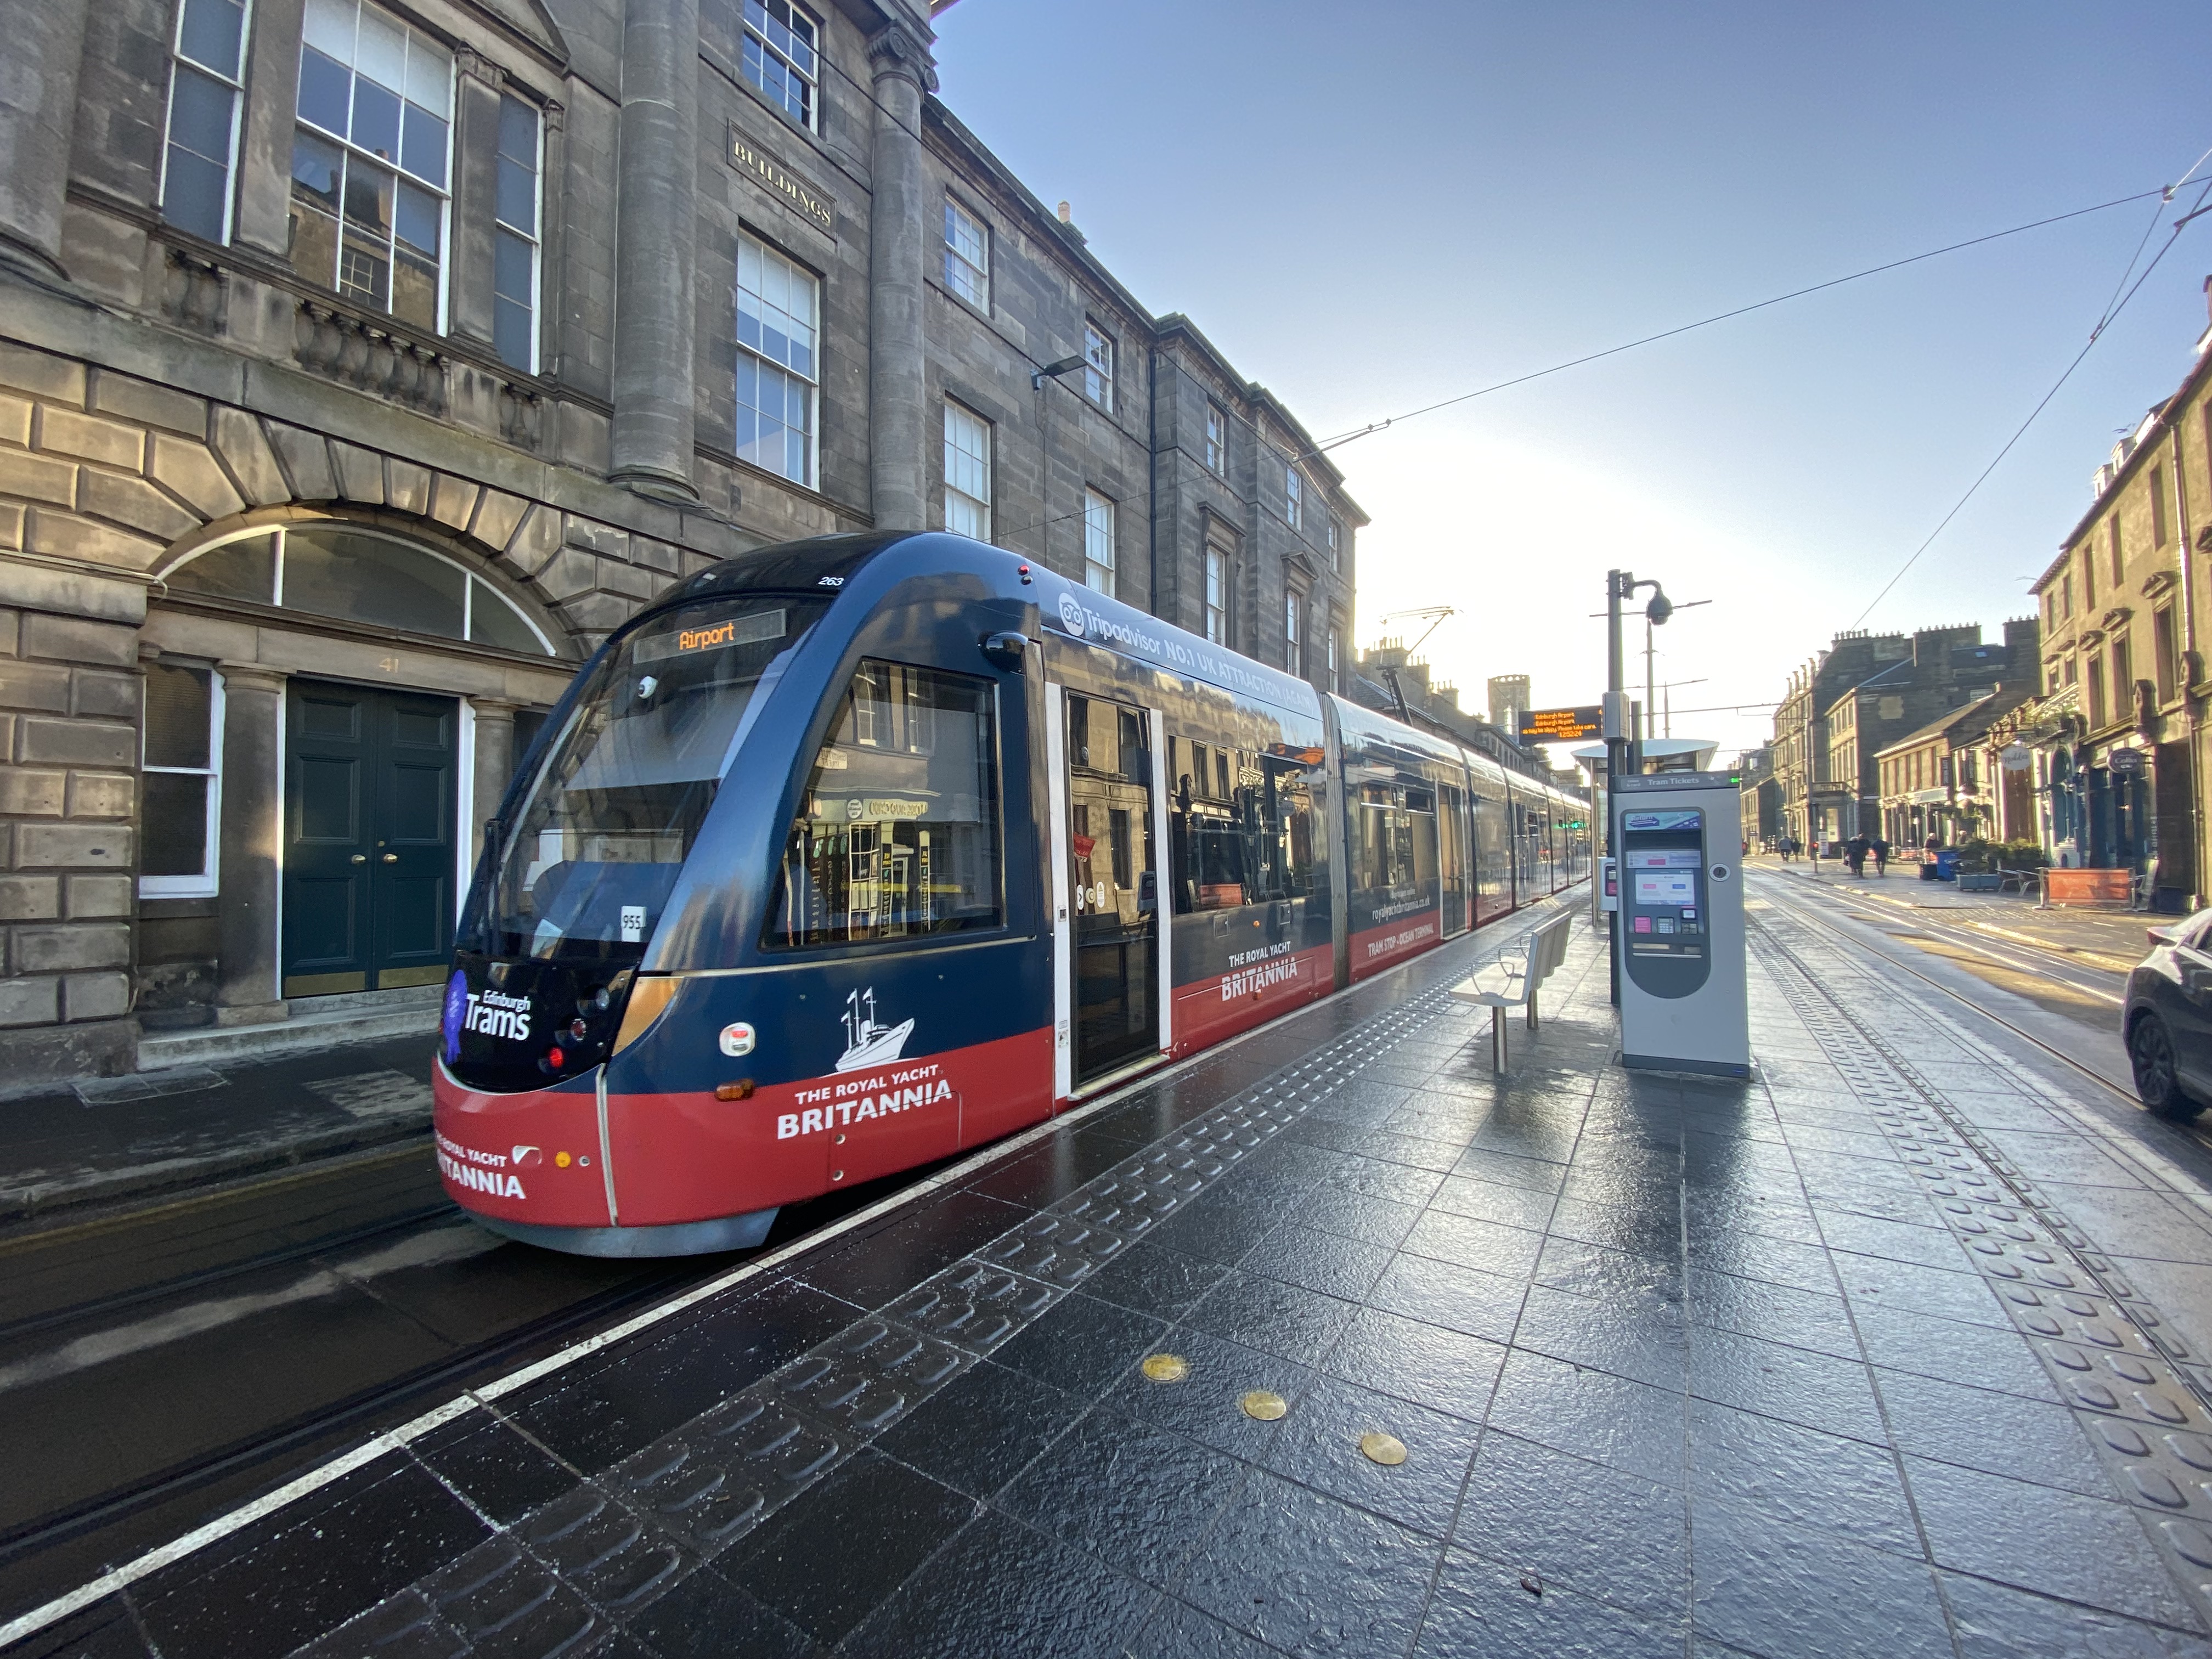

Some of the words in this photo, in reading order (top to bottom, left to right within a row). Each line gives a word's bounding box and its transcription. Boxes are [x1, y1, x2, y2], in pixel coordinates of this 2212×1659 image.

[734, 141, 831, 224] BUILDINGS
[818, 577, 844, 586] 263
[680, 623, 734, 650] Airport
[379, 658, 399, 673] 41
[1083, 607, 1160, 654] Tripadvisor
[1164, 639, 1195, 668] NO.1
[1197, 652, 1217, 675] UK
[1219, 662, 1282, 700] ATTRACTION
[1283, 686, 1314, 714] (AGAIN)
[623, 915, 641, 929] 955
[1228, 952, 1244, 968] THE
[1246, 947, 1268, 963] ROYAL
[1269, 940, 1290, 956] YACHT
[1368, 939, 1384, 957] TRAM
[1384, 936, 1396, 951] STOP
[1400, 930, 1414, 945] OCEAN
[1415, 923, 1434, 939] TERMINAL
[1221, 957, 1297, 1001] BRITANNIA
[483, 990, 531, 1013] Edinburgh
[465, 994, 532, 1041] Trams
[795, 1087, 831, 1105] THE
[836, 1076, 887, 1097] ROYAL
[891, 1064, 939, 1084] YACHT
[777, 1080, 952, 1139] BRITANNIA
[467, 1149, 507, 1167] YACHT
